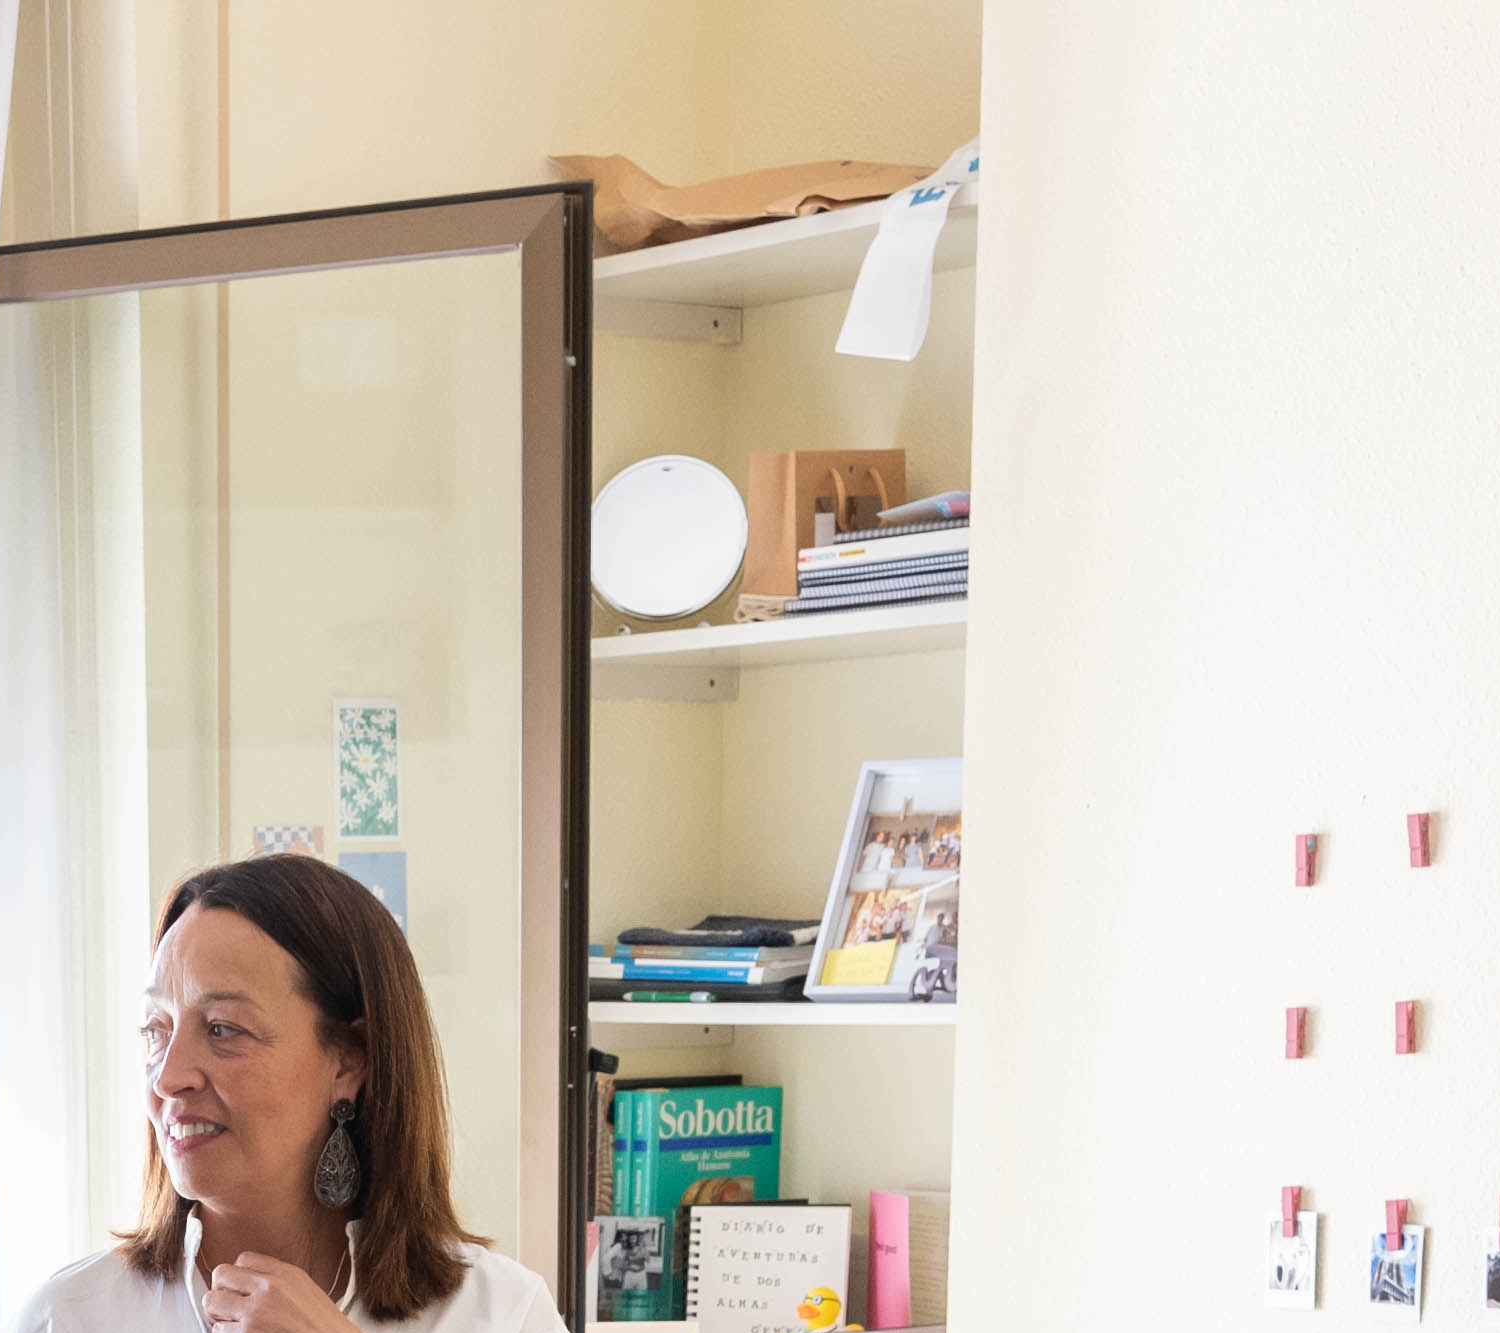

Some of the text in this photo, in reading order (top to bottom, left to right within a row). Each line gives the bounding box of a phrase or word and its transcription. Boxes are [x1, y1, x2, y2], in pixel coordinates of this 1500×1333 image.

[658, 1099, 774, 1140] Sobotta
[721, 1222, 824, 1235] DIARIO DE
[757, 1276, 782, 1288] DOS
